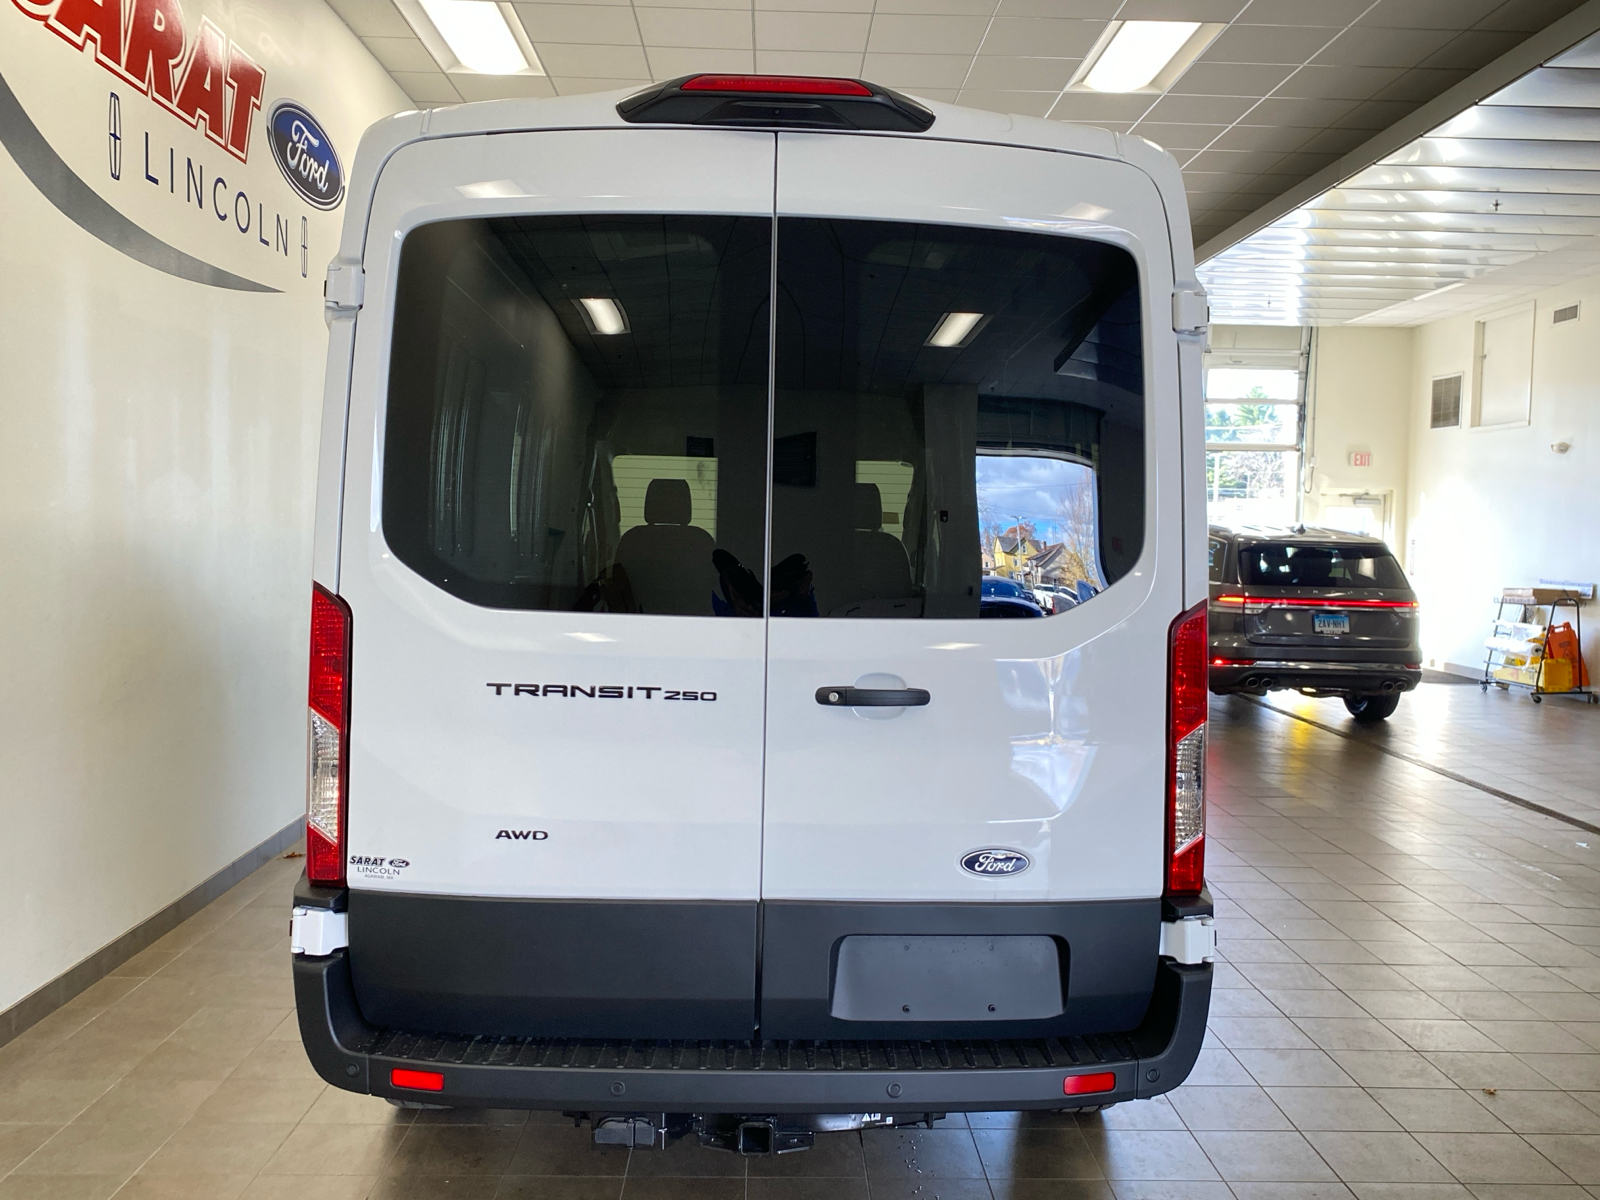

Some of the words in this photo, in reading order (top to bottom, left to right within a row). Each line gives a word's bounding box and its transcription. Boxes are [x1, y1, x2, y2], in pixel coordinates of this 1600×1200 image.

[286, 119, 330, 193] Ford
[144, 131, 288, 257] LINCOLN
[1353, 453, 1371, 466] EXIT
[486, 683, 662, 700] TRANSIT
[664, 690, 717, 702] 250
[495, 829, 549, 841] AWD
[350, 855, 386, 866] SARAT
[974, 853, 1017, 872] Ford
[357, 867, 400, 875] LINCOLN
